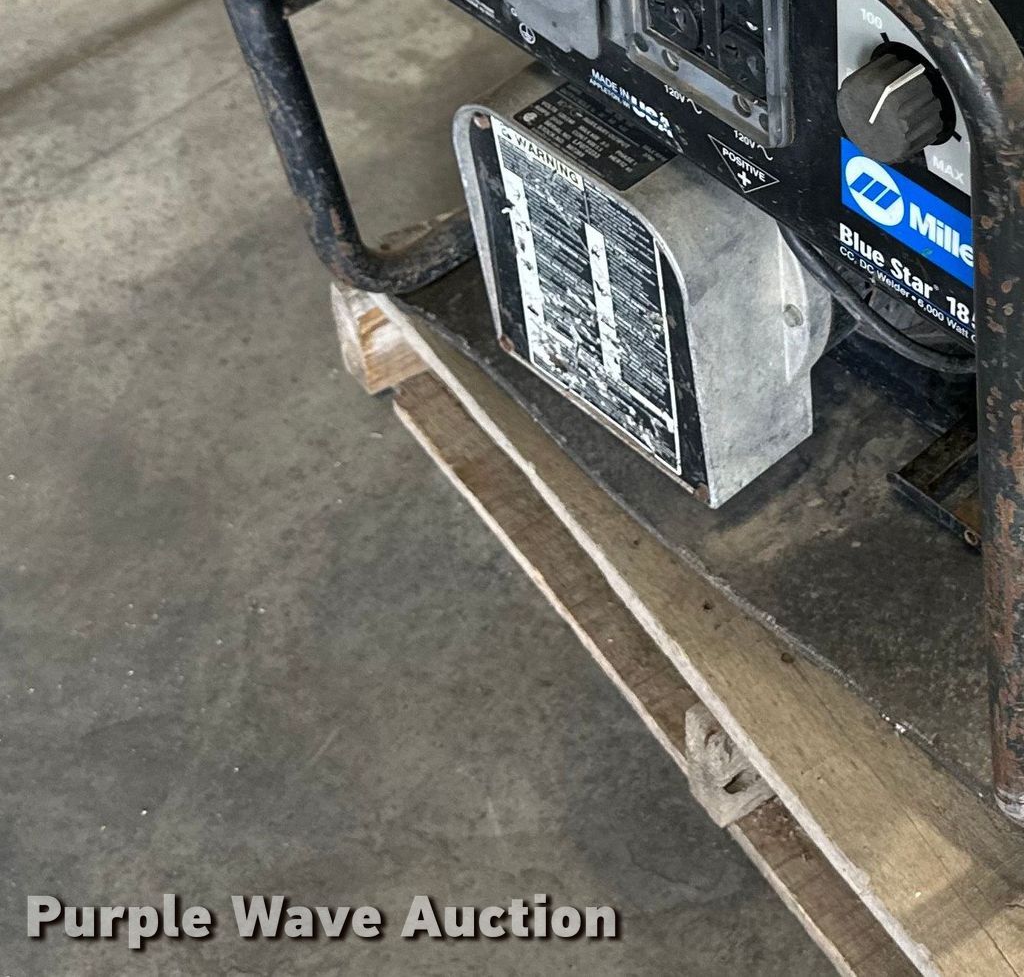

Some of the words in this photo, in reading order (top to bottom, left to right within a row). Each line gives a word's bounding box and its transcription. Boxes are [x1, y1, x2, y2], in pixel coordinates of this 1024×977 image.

[860, 8, 883, 29] 100
[591, 68, 618, 93] MADE
[619, 86, 630, 100] IN
[664, 84, 686, 103] 120V
[733, 129, 756, 149] 120V
[516, 134, 579, 185] WARNING
[721, 147, 766, 182] POSITIVE
[932, 155, 965, 184] MAX
[909, 203, 974, 268] Mille
[840, 222, 885, 268] Blue
[946, 296, 976, 329] 18
[860, 259, 875, 274] DC
[877, 270, 911, 298] Welder
[917, 298, 945, 322] 6,000
[946, 316, 970, 339] Watt
